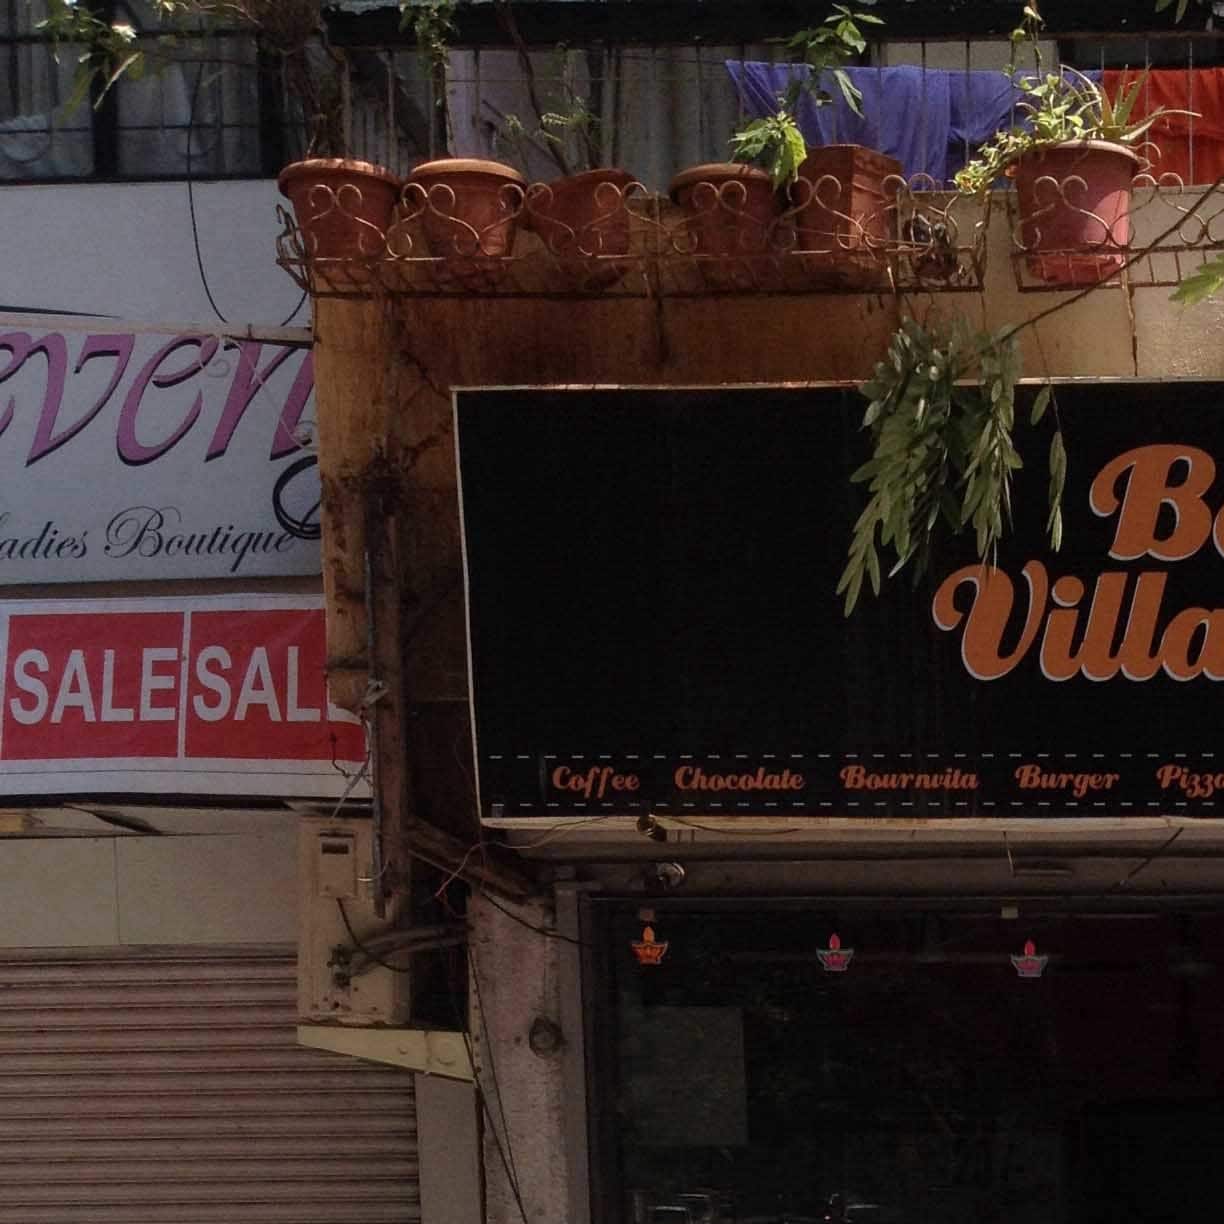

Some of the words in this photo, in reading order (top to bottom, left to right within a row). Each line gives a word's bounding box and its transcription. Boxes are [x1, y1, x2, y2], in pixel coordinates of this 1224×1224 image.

[0, 332, 316, 466] ven
[0, 512, 88, 560] adies
[104, 506, 296, 572] Boutique
[10, 648, 178, 724] SALE
[194, 646, 358, 723] SAL
[552, 765, 640, 798] Coffee
[674, 765, 806, 791] Chocolate
[840, 765, 978, 791] Bournvita
[1014, 764, 1120, 798] Burger
